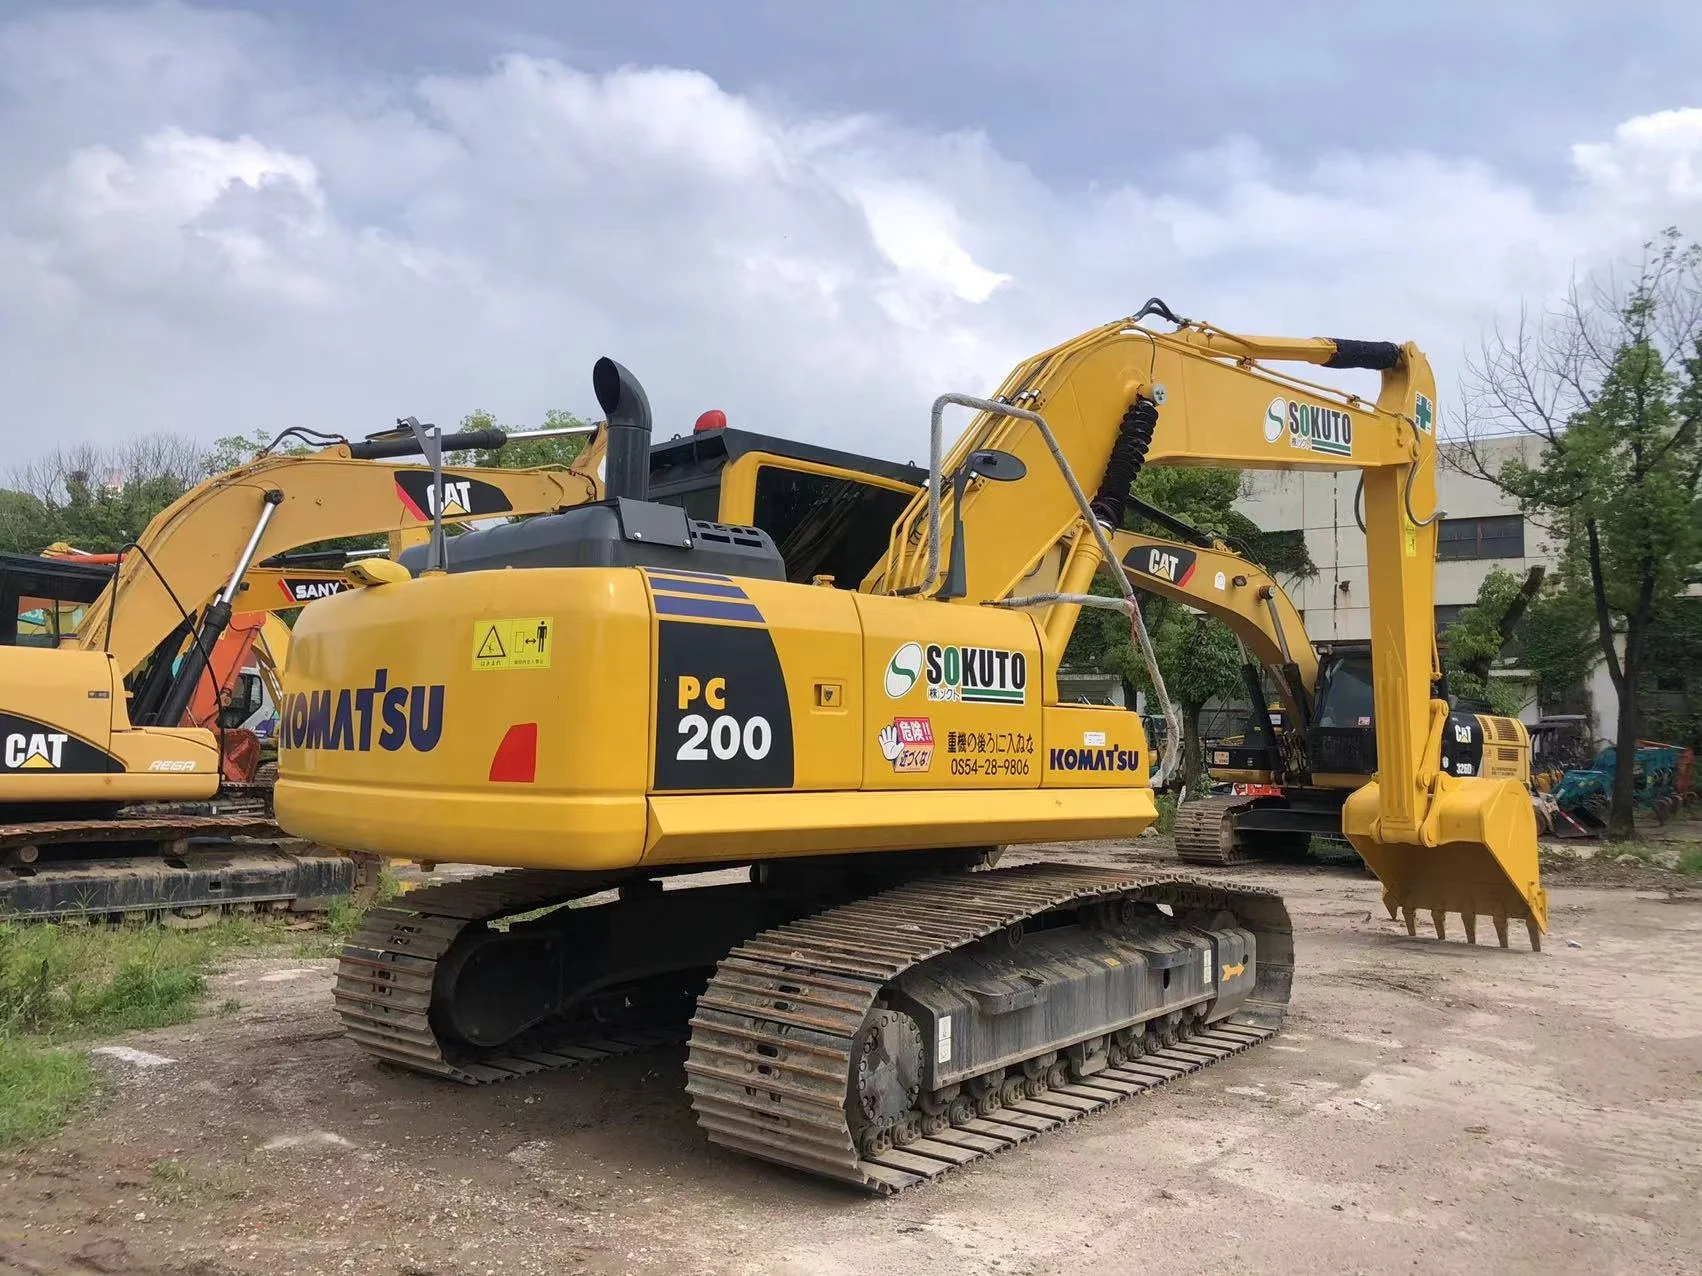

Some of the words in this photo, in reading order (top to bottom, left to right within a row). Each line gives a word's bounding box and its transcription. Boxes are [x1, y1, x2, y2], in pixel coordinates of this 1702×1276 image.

[1289, 402, 1351, 444] SOKUTO
[1148, 548, 1179, 582] CAT
[295, 582, 340, 599] SANY
[926, 644, 1026, 689] SOKUTO
[280, 668, 445, 752] KOMATSU
[678, 675, 726, 710] PC
[5, 733, 68, 768] CAT
[676, 714, 772, 761] 200
[1454, 725, 1472, 743] CAT
[1050, 744, 1139, 771] KOMATSU
